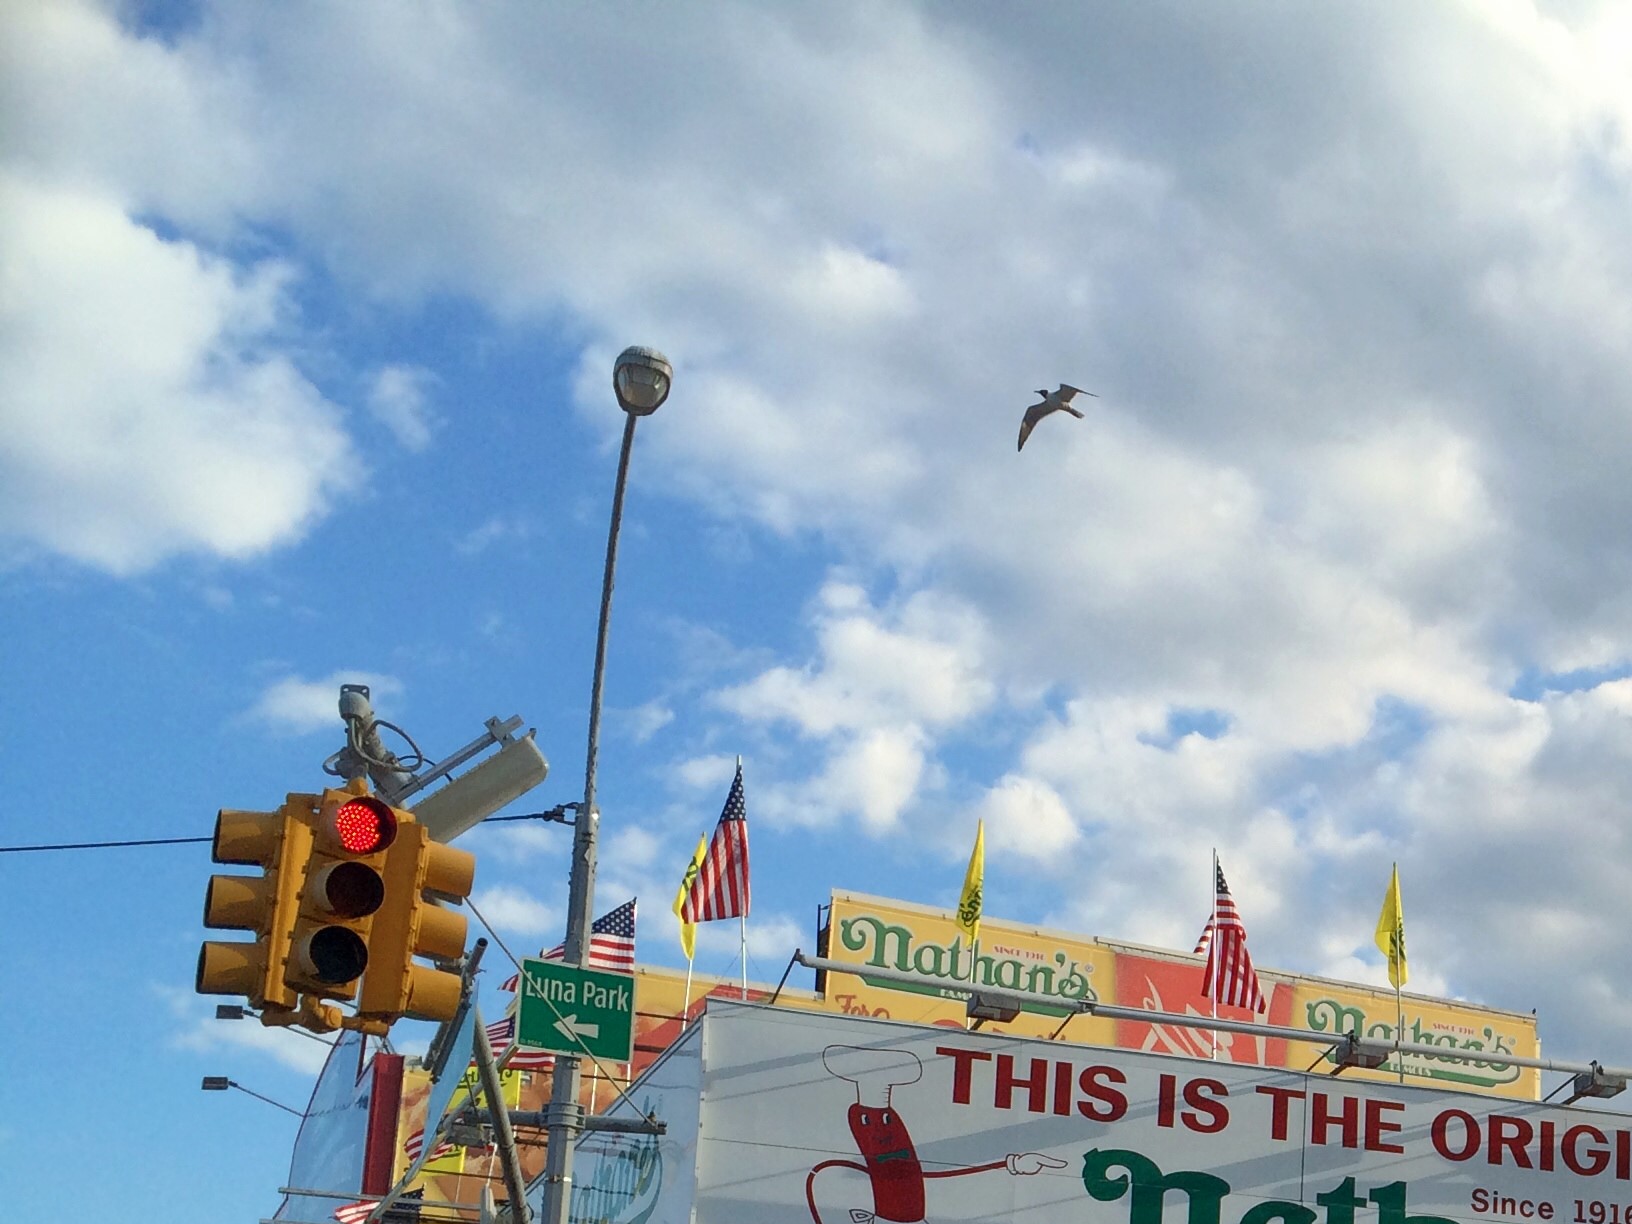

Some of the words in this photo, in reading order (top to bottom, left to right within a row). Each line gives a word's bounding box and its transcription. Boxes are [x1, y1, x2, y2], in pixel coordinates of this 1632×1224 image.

[524, 971, 575, 1004] Luna
[582, 981, 629, 1012] Park
[936, 1046, 1128, 1123] THIS
[1158, 1074, 1229, 1134] IS
[1256, 1085, 1405, 1154] THE
[1471, 1187, 1554, 1220] Since
